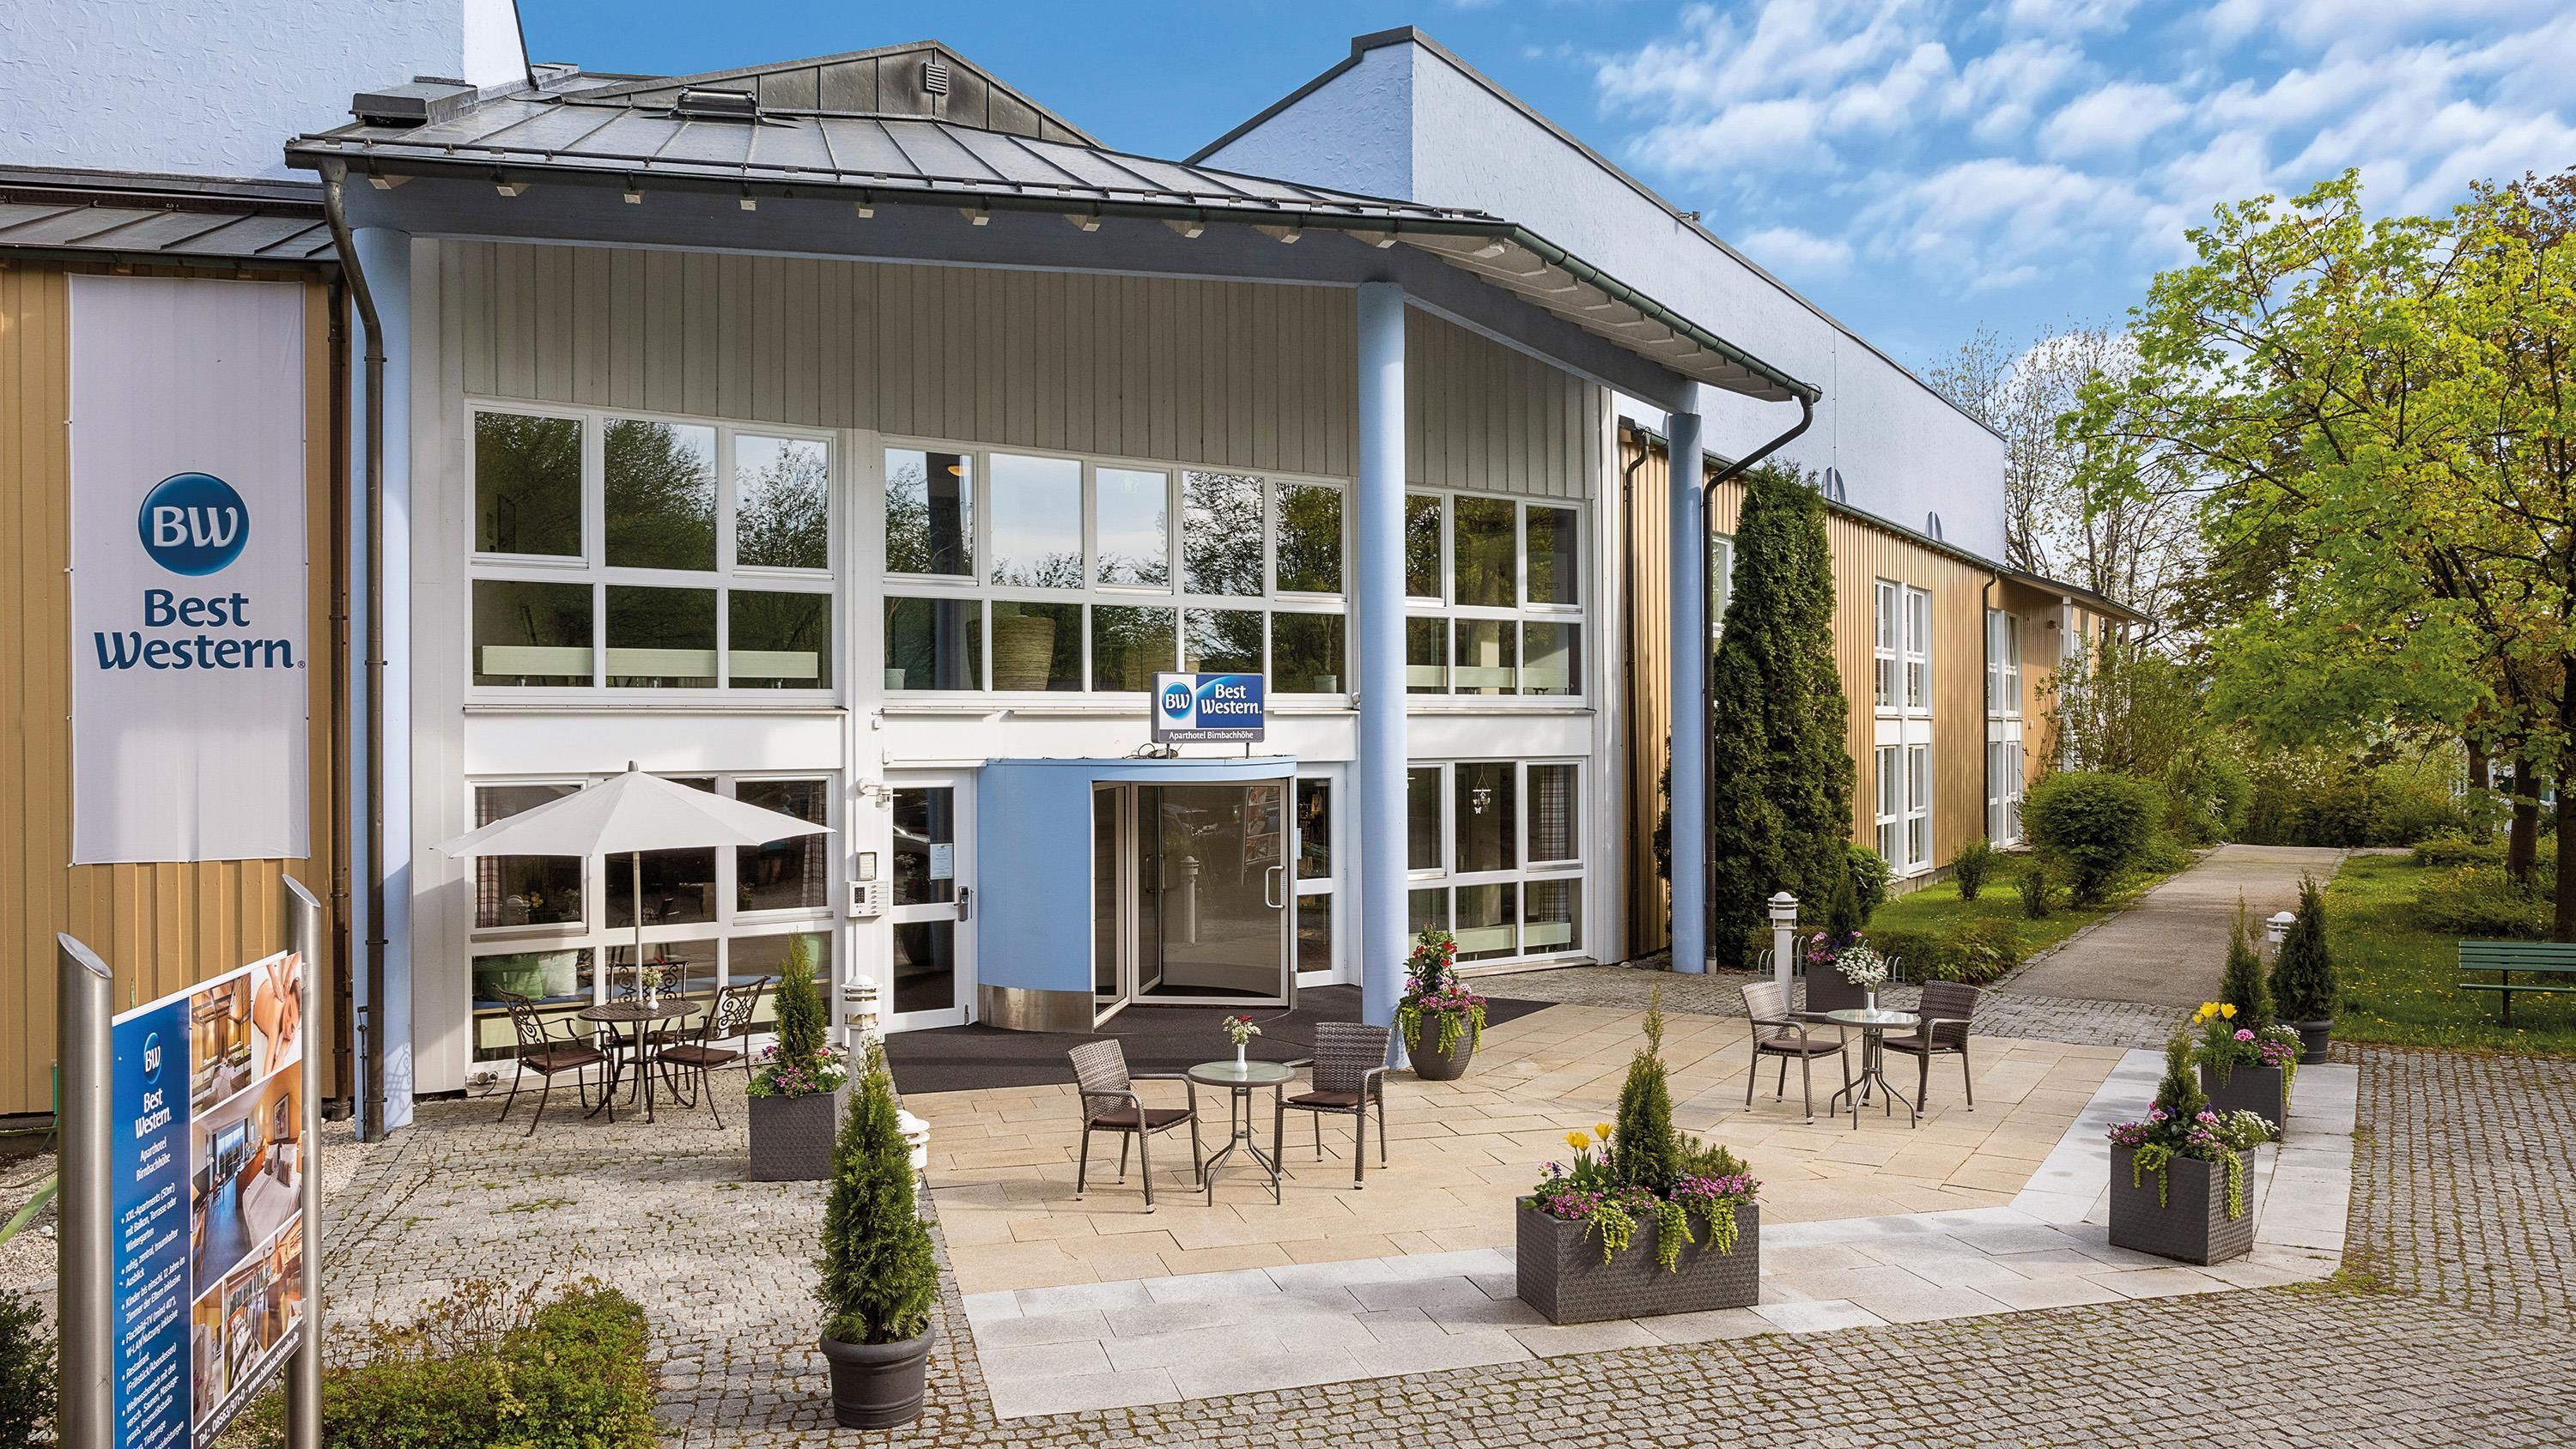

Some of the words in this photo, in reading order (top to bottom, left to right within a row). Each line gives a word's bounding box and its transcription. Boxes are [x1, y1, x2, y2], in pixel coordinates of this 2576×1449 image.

[153, 506, 238, 547] BW
[143, 588, 250, 627] Best
[1165, 694, 1190, 709] BW
[1215, 683, 1246, 699] Best
[1169, 731, 1206, 740] Aparthotel
[145, 1046, 161, 1072] BW
[143, 1088, 163, 1113] Best
[140, 1136, 167, 1162] Aparthotel
[136, 1153, 171, 1182] Birnbachhöhe
[125, 1193, 161, 1223] XXL-Apartments
[133, 1216, 149, 1233] Balkon,
[149, 1203, 167, 1221] Terrasse
[167, 1197, 177, 1210] oder
[125, 1228, 155, 1252] Wintergarten
[155, 1229, 179, 1252] traumhafter
[125, 1267, 144, 1288] Ausblick
[125, 1291, 141, 1308] Kinder
[163, 1268, 168, 1279] 12
[168, 1261, 180, 1275] Jahre
[179, 1257, 185, 1266] im
[125, 1304, 143, 1324] Zimmer
[150, 1288, 164, 1303] Eltern
[163, 1274, 181, 1293] inklusive
[125, 1313, 153, 1343] Flachbild-TV
[143, 1324, 161, 1344] Nutzung
[161, 1309, 178, 1330] inklusive
[125, 1351, 149, 1379] Restaurant
[247, 1331, 299, 1394] www.birnbachhoehe.de
[126, 1375, 161, 1413] Wellnessbereich
[167, 1360, 177, 1375] drei
[141, 1394, 173, 1430] Kosmetikstudio
[143, 1420, 166, 1447] Tiefgarage
